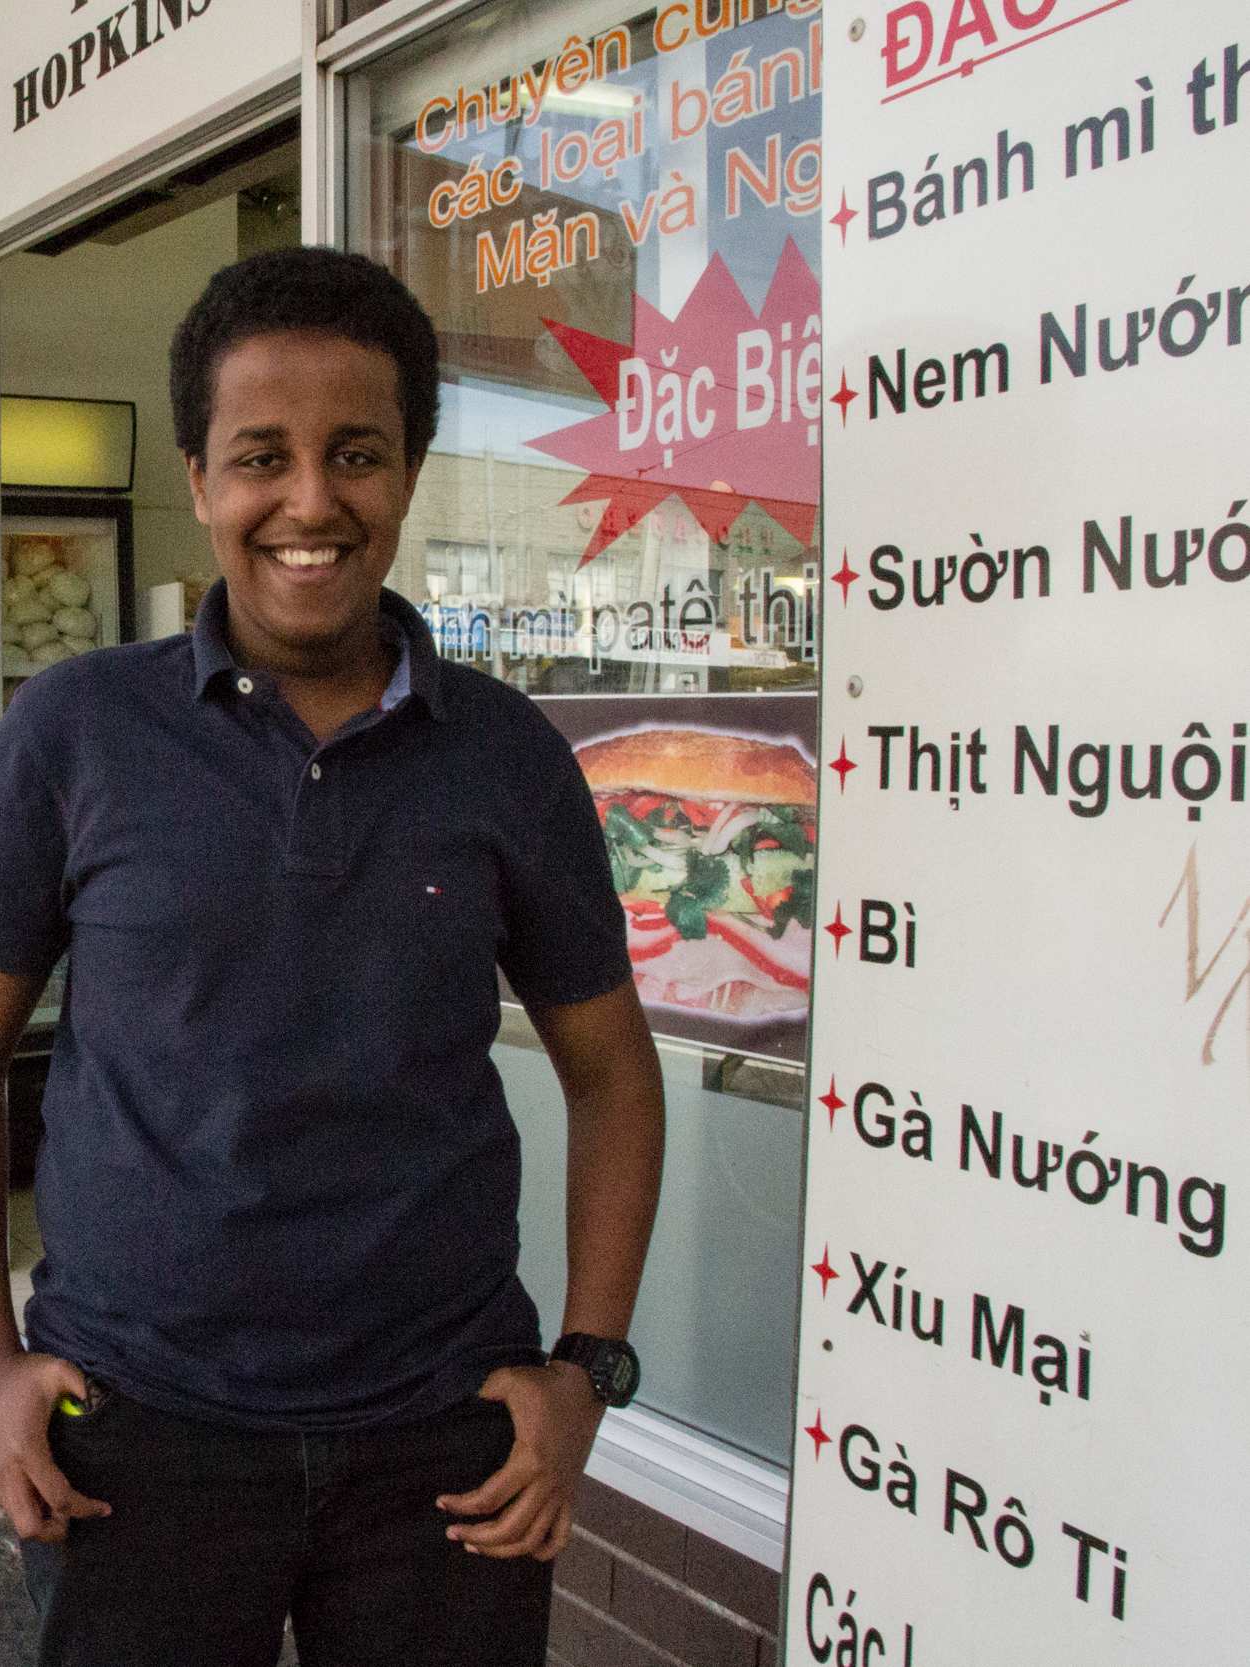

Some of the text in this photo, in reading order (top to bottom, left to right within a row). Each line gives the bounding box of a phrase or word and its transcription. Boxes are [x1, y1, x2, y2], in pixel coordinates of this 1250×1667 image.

[415, 0, 823, 155] Chuyên cu
[428, 153, 522, 229] các
[540, 95, 646, 192] loại
[867, 129, 1035, 242] Bánh
[1064, 75, 1155, 179] mì
[476, 207, 601, 294] Mặn
[620, 171, 698, 248] và
[615, 346, 716, 469] Đặc
[868, 341, 1009, 420] Nem
[588, 577, 716, 675] patê
[868, 533, 1050, 611] Sườn
[867, 722, 1248, 822] Thịt Nguội
[859, 898, 917, 969] Bì
[853, 1081, 1227, 1259] Gà Nướng
[846, 1251, 1091, 1407] Xíu Mại
[839, 1423, 1128, 1622] Gà Rô Ti
